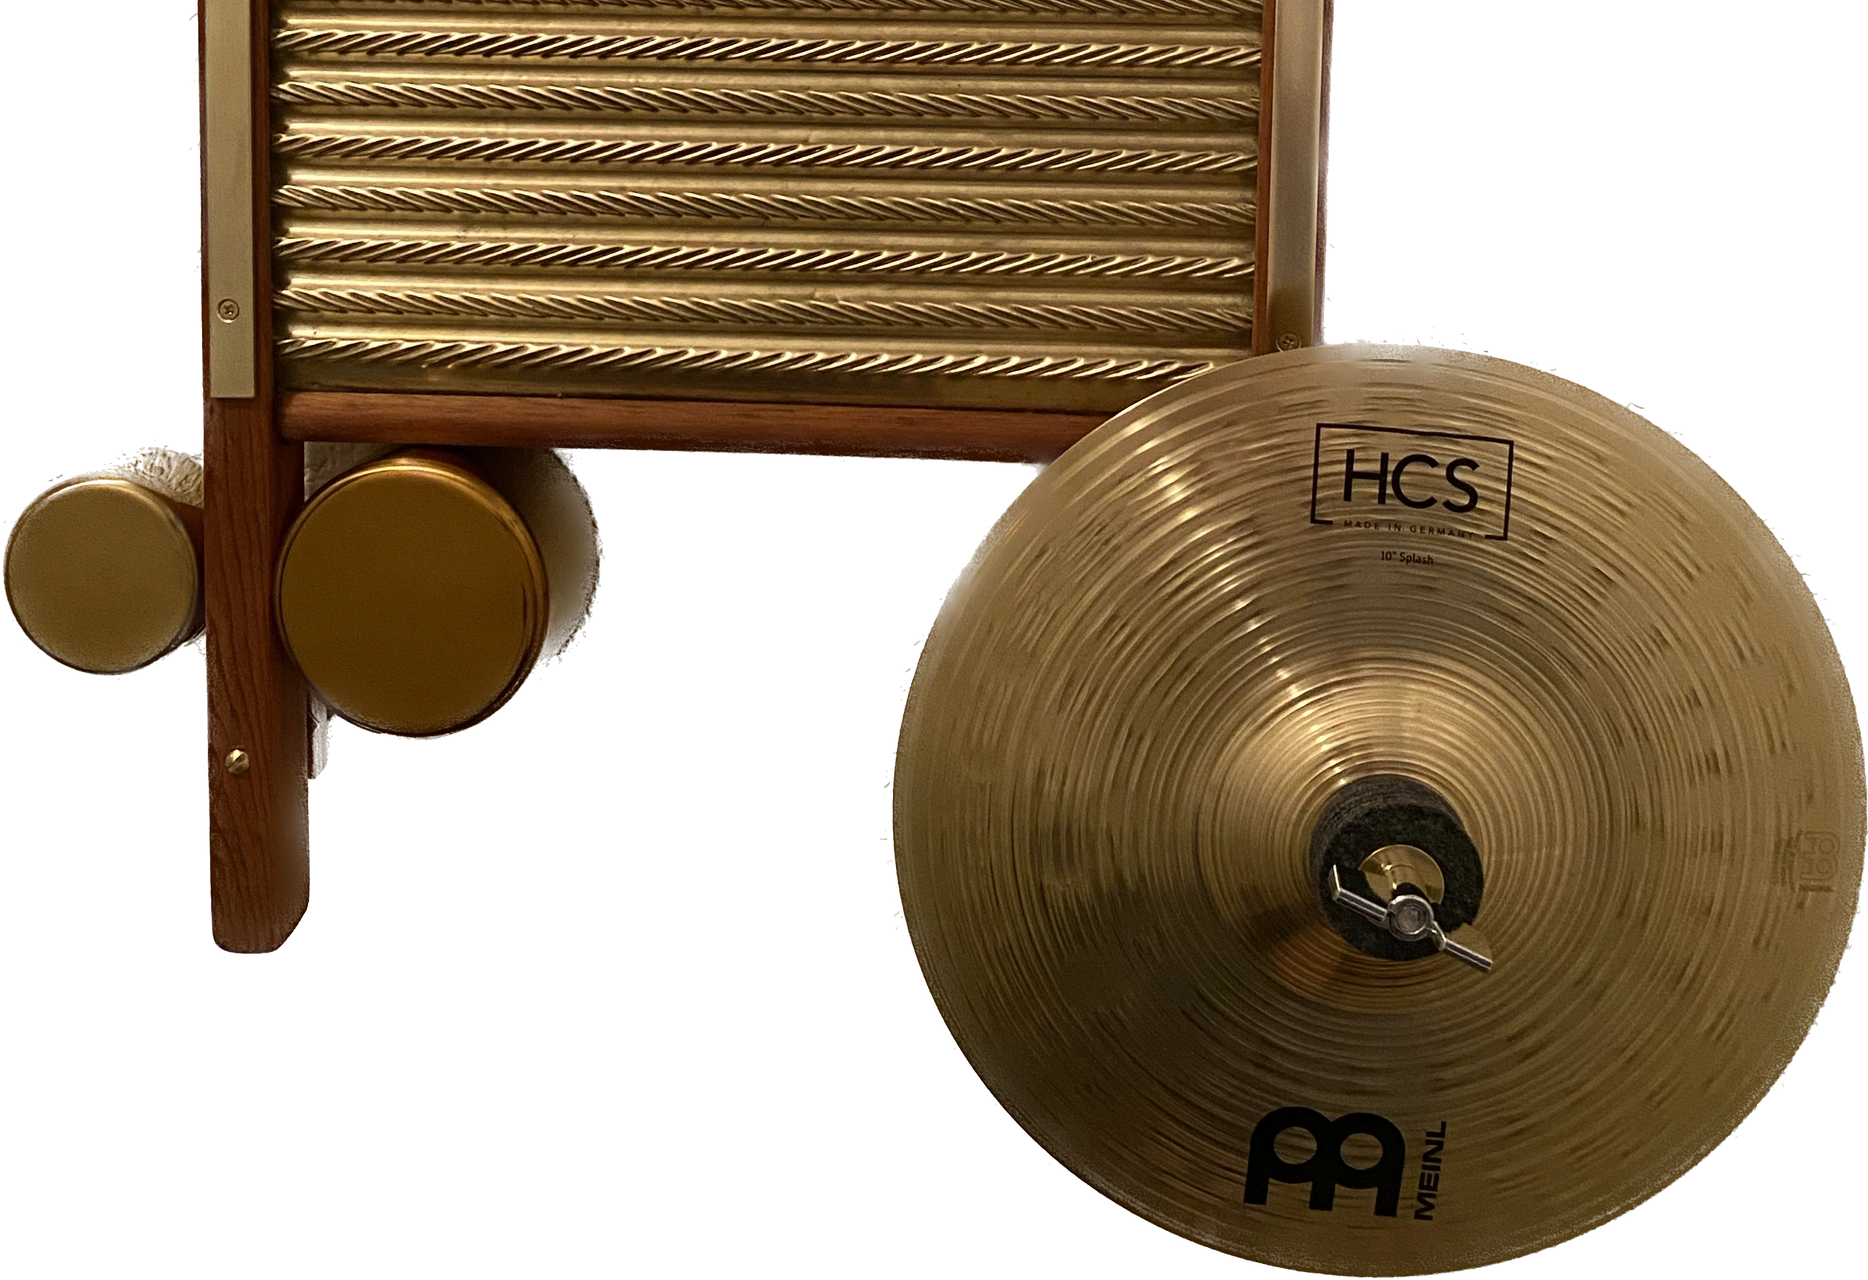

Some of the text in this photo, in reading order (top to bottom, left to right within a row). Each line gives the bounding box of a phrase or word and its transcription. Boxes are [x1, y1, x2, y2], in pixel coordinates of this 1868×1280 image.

[1343, 448, 1480, 513] HCS
[1343, 520, 1475, 539] MADE IN GERMANY
[1380, 550, 1434, 565] 10" Splash
[1413, 1121, 1447, 1220] MEINL
